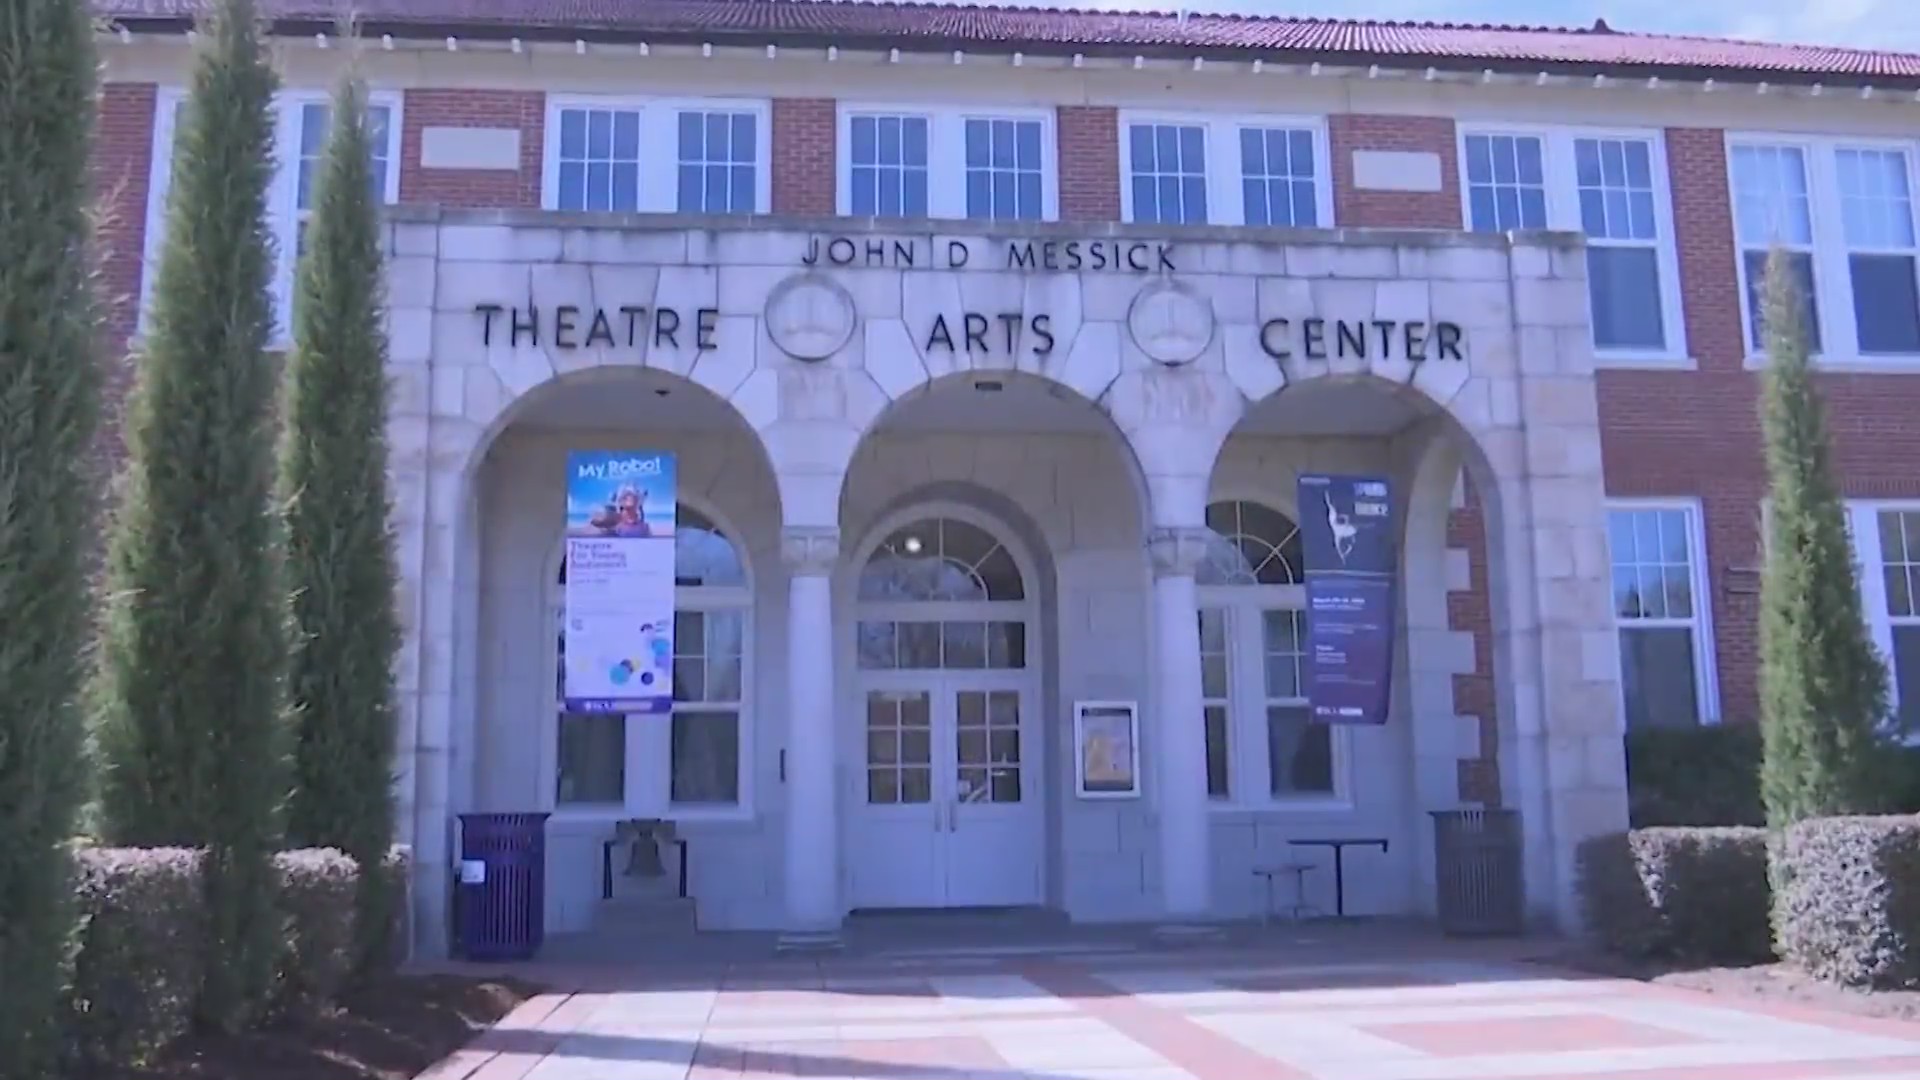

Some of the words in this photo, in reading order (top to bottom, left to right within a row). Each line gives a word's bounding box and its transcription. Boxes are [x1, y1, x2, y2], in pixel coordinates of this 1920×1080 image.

[802, 239, 914, 266] JOHN
[948, 241, 969, 268] D
[1007, 242, 1177, 271] MESSICK
[475, 304, 719, 351] THEATRE
[925, 313, 1055, 355] ARTS
[1259, 317, 1464, 362] CENTER
